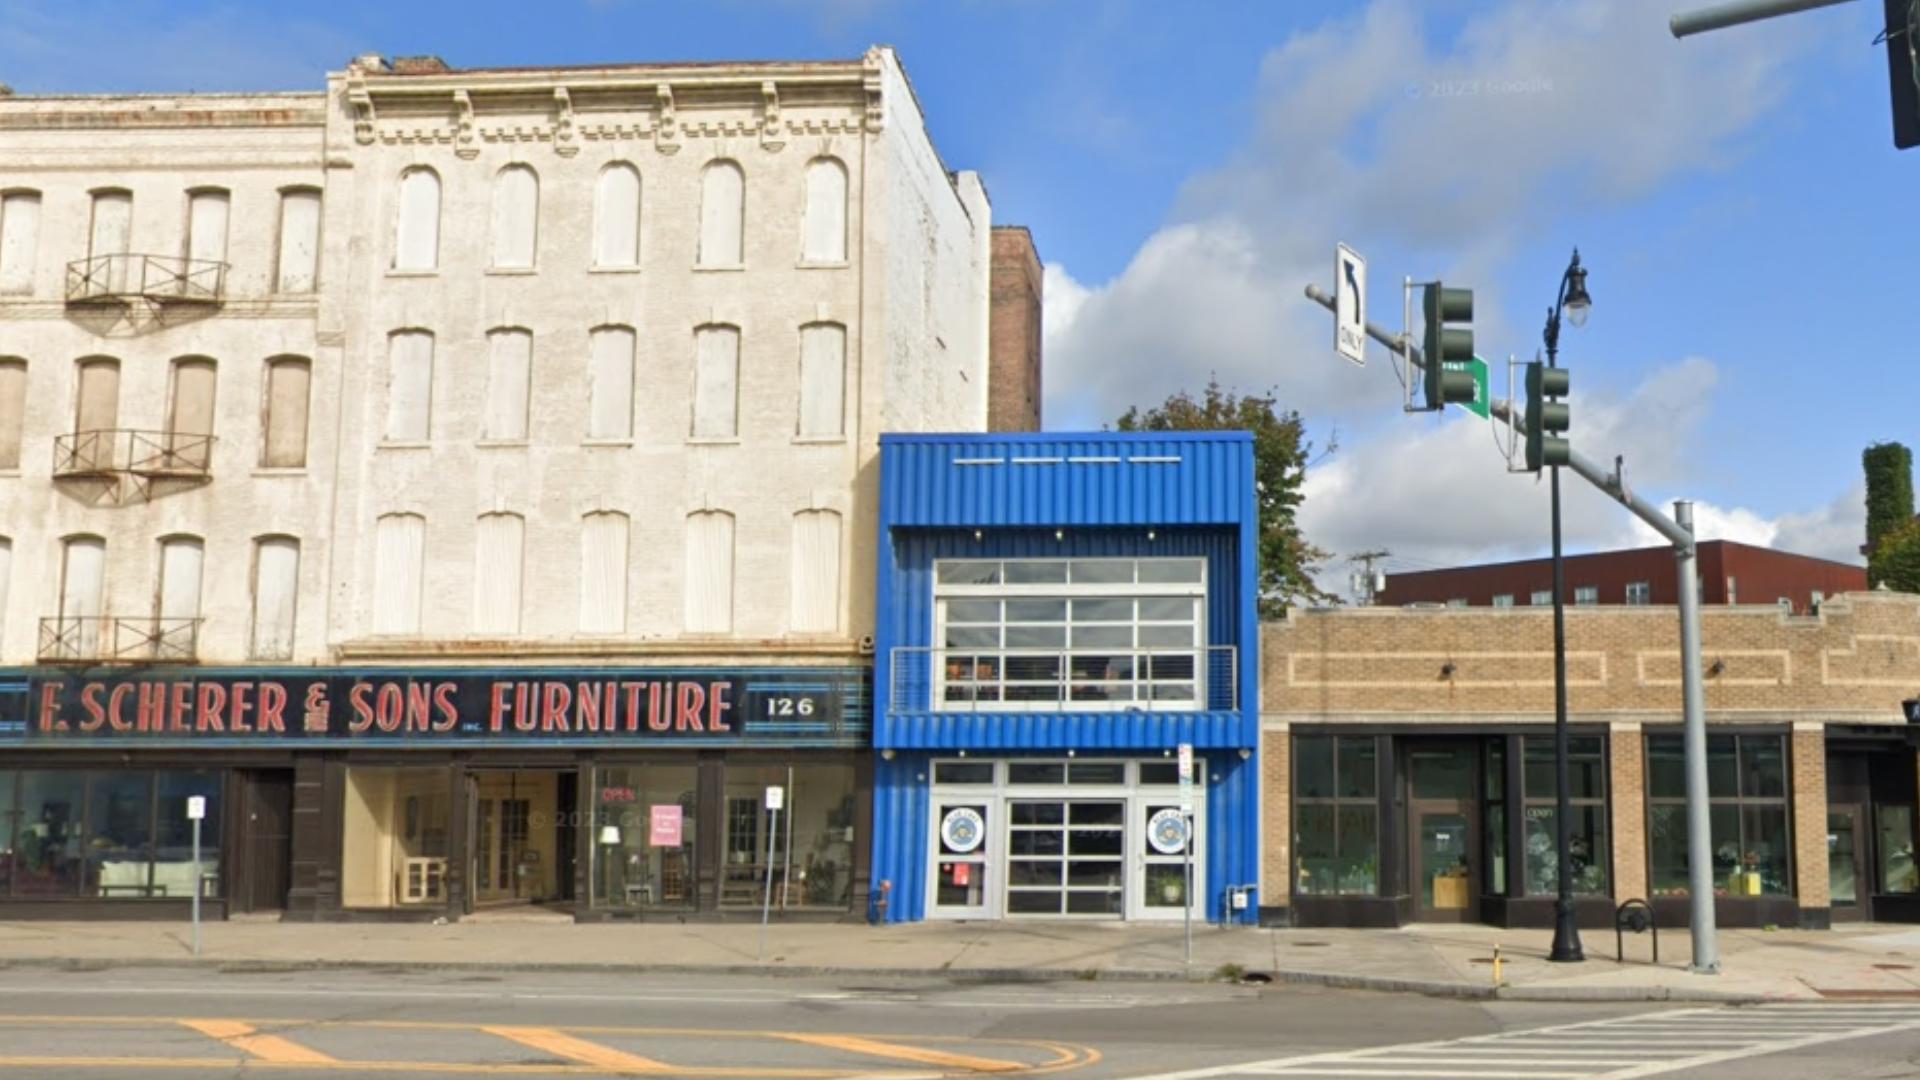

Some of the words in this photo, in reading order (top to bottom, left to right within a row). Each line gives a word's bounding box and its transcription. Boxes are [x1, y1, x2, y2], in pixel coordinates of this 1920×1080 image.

[80, 682, 286, 732] SCHERER
[304, 682, 330, 732] &
[349, 682, 459, 732] SONS
[490, 681, 732, 731] FURNITURE
[767, 697, 815, 716] 126
